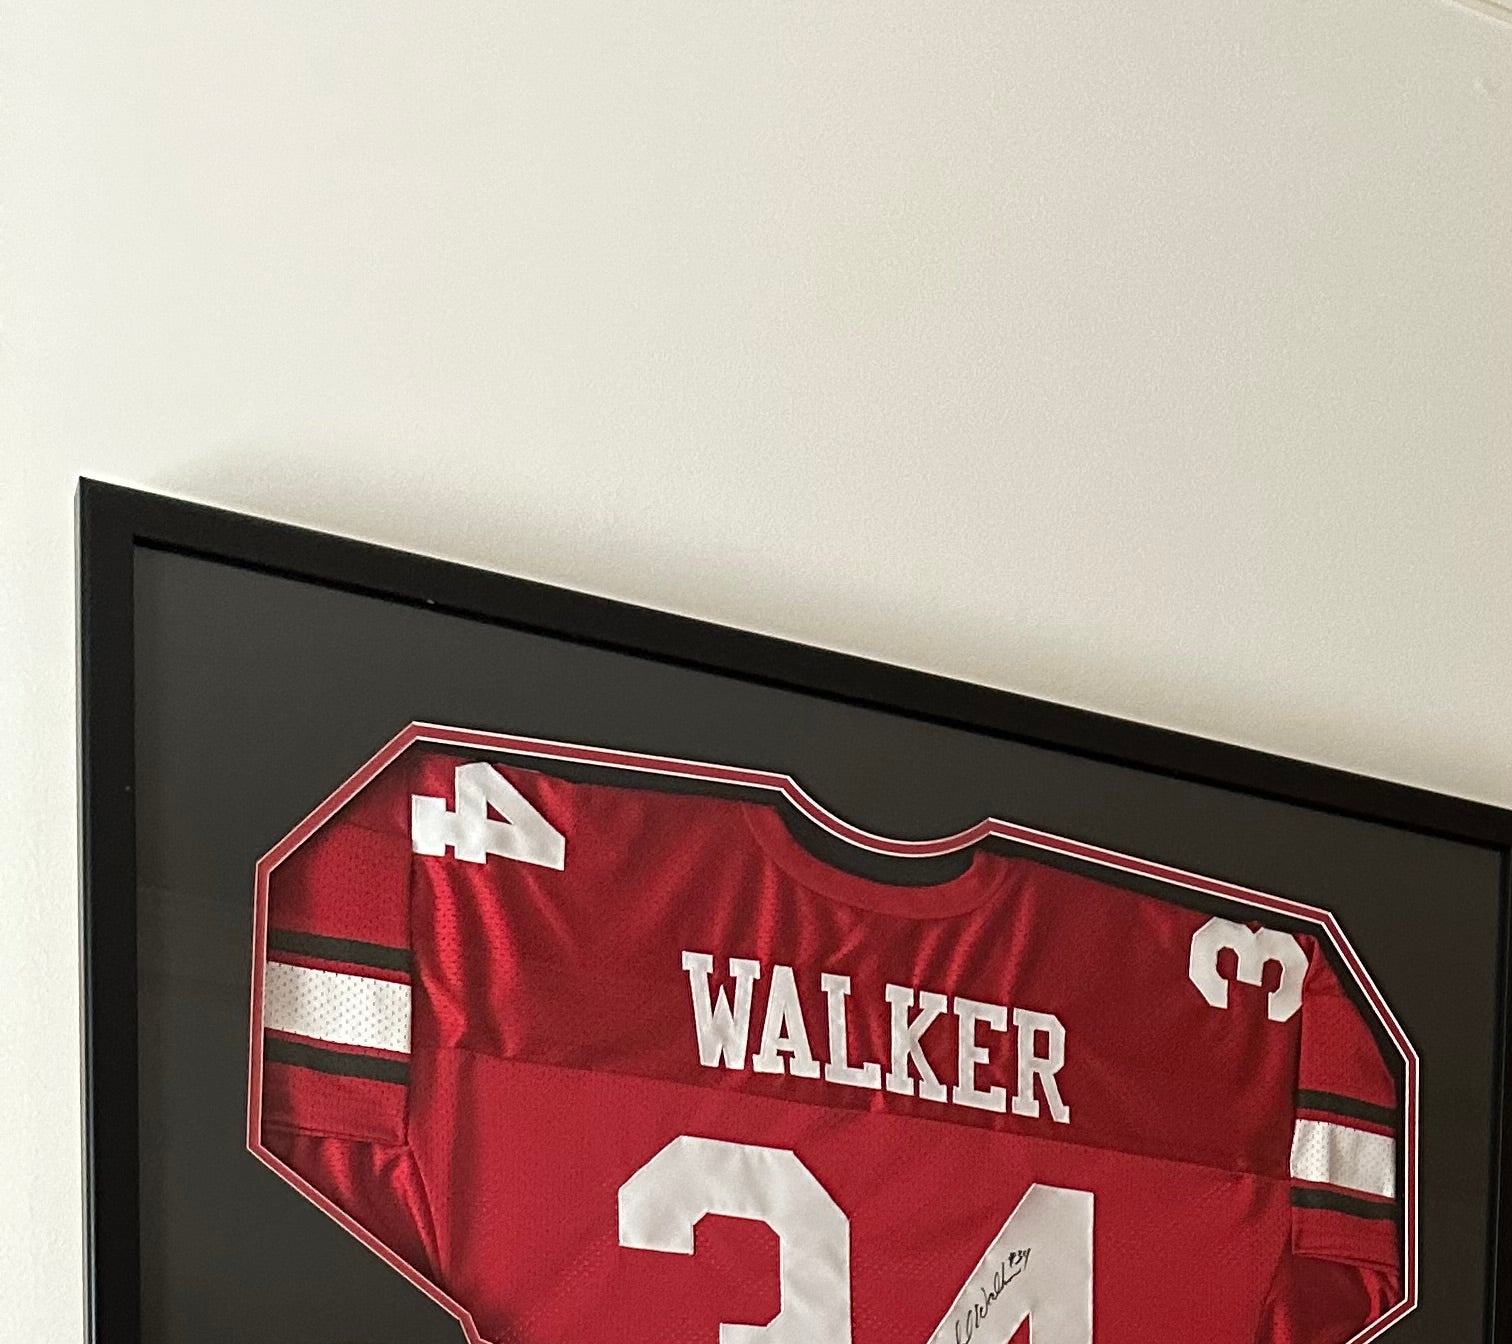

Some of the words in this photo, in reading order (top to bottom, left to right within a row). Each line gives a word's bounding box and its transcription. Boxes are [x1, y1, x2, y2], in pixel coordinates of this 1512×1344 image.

[411, 761, 566, 872] 4
[1188, 915, 1310, 1023] 3
[681, 950, 1071, 1125] WALKER
